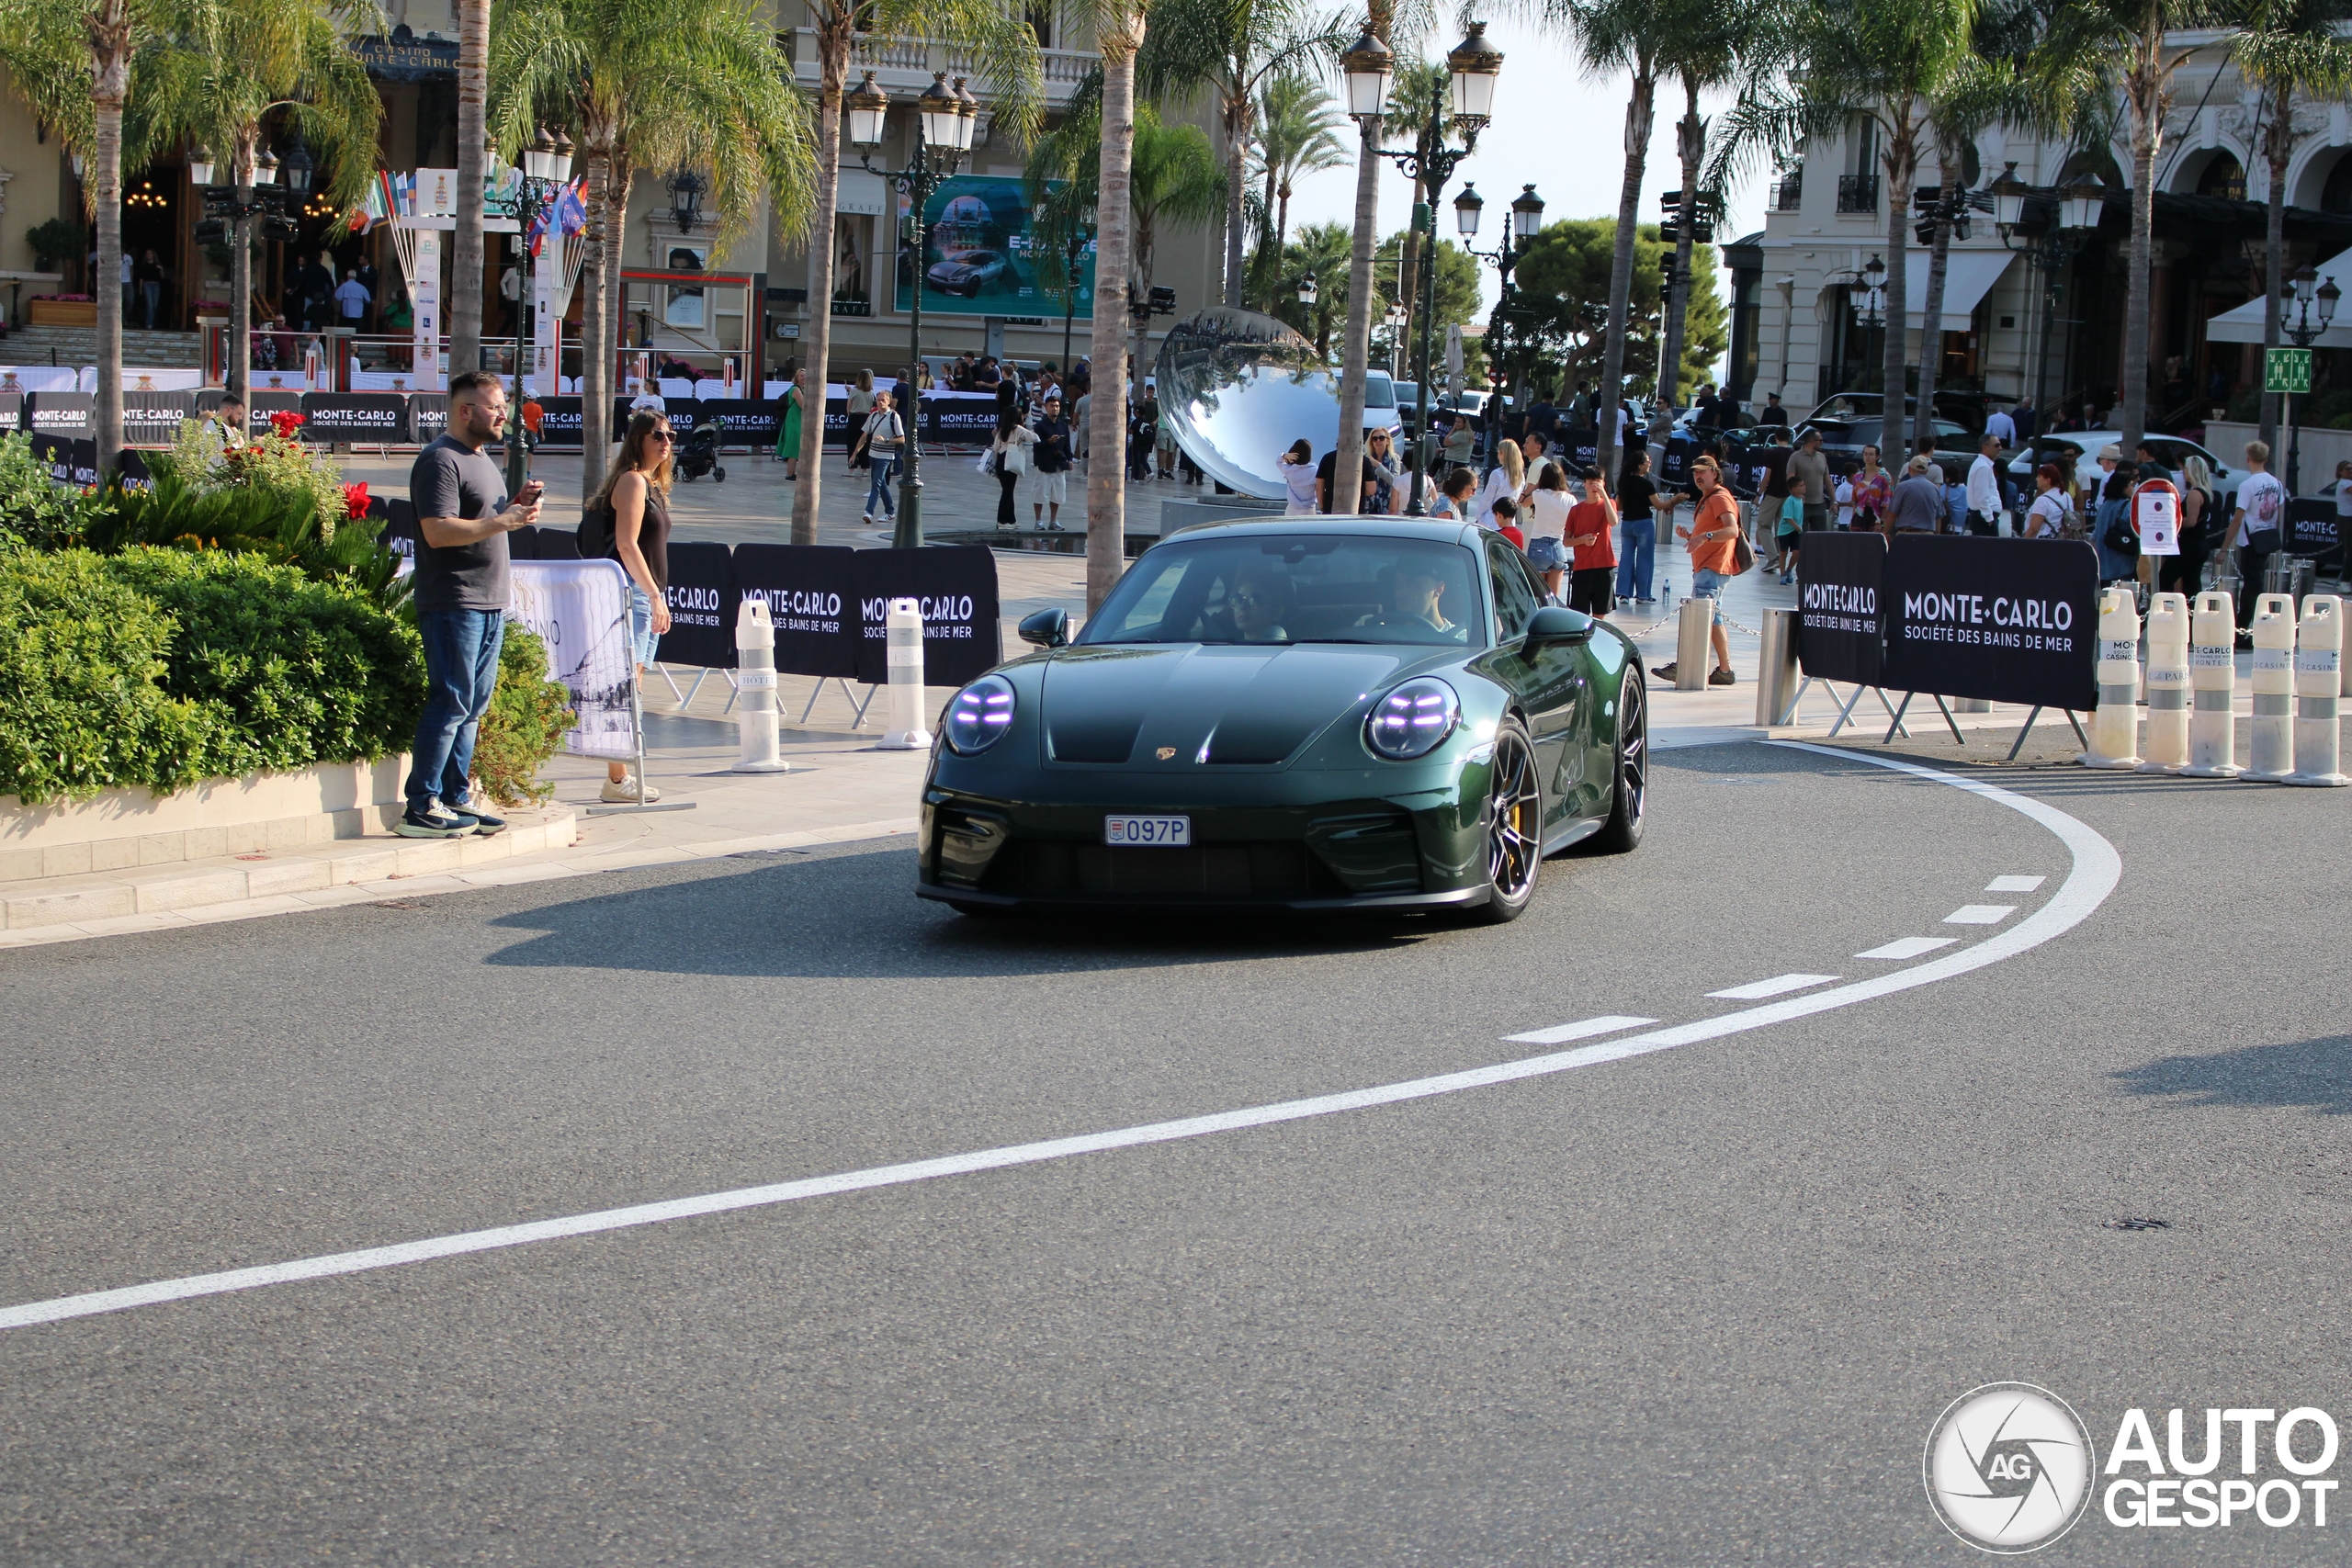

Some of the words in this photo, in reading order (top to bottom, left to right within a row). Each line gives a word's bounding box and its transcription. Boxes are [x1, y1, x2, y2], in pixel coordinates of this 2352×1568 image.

[375, 45, 431, 57] CASINO
[351, 51, 460, 69] ONTE-CARLO
[838, 203, 882, 213] GRAFF
[833, 305, 867, 313] RAFF
[675, 614, 695, 625] BAINS
[695, 616, 704, 626] DE
[706, 616, 719, 626] MER
[775, 617, 786, 628] DES
[789, 619, 809, 631] BAINS
[811, 621, 820, 631] DE
[822, 622, 839, 633] MER
[1827, 616, 1838, 629] DES
[1864, 620, 1876, 633] MER
[940, 626, 950, 637] DE
[953, 626, 972, 637] MER
[1905, 625, 1954, 642] SOCIÉTÉ
[1958, 629, 1980, 644] DES
[1984, 631, 2020, 648] BAINS
[2025, 635, 2041, 649] DE
[2045, 637, 2073, 652] MER
[1127, 820, 1184, 842] 097P
